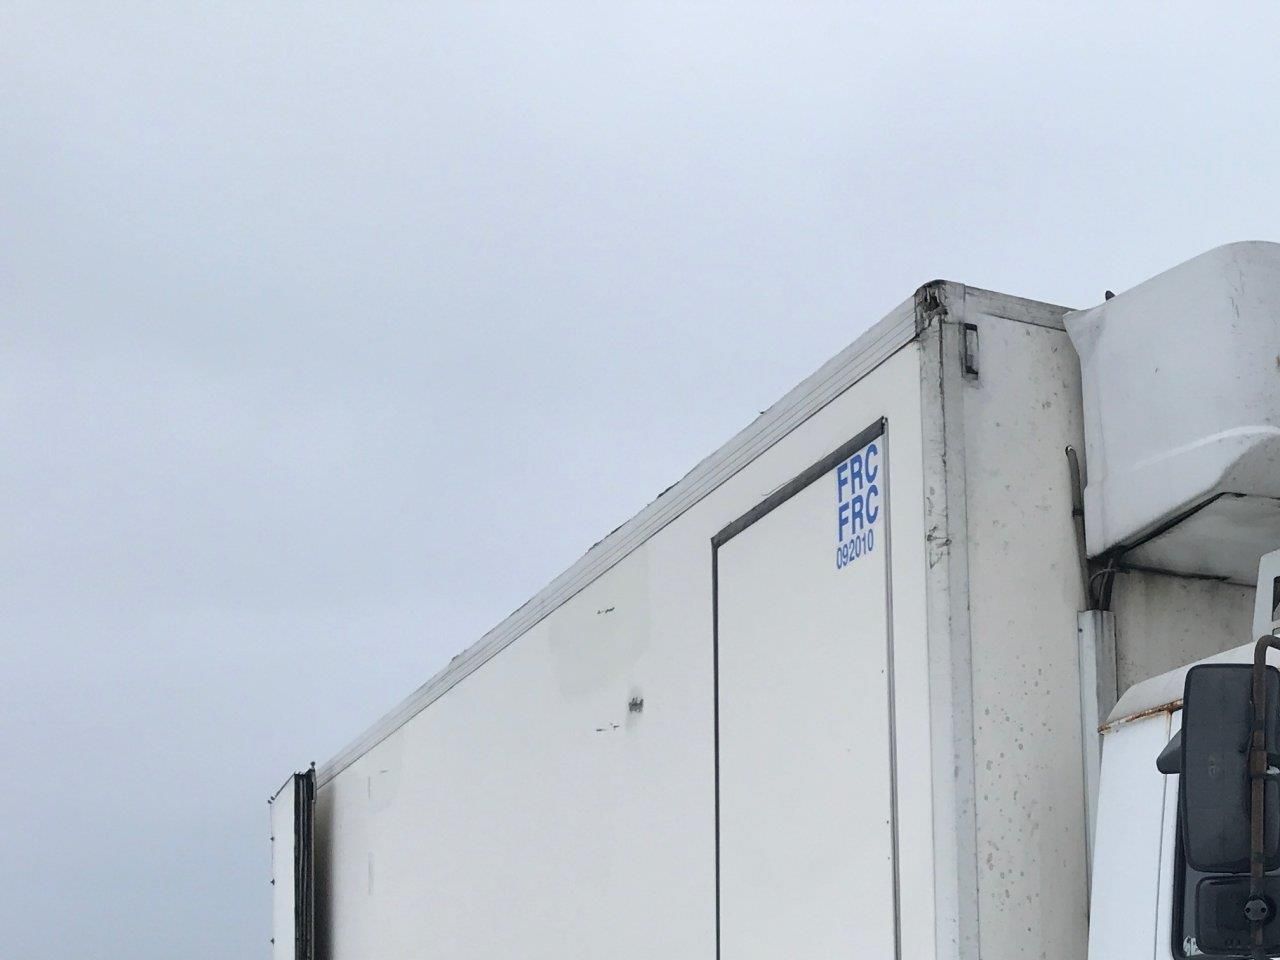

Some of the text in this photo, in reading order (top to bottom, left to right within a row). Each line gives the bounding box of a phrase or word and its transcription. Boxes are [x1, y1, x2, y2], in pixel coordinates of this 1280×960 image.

[837, 444, 878, 503] FRC
[838, 485, 879, 542] FRC
[836, 528, 874, 570] 092010
